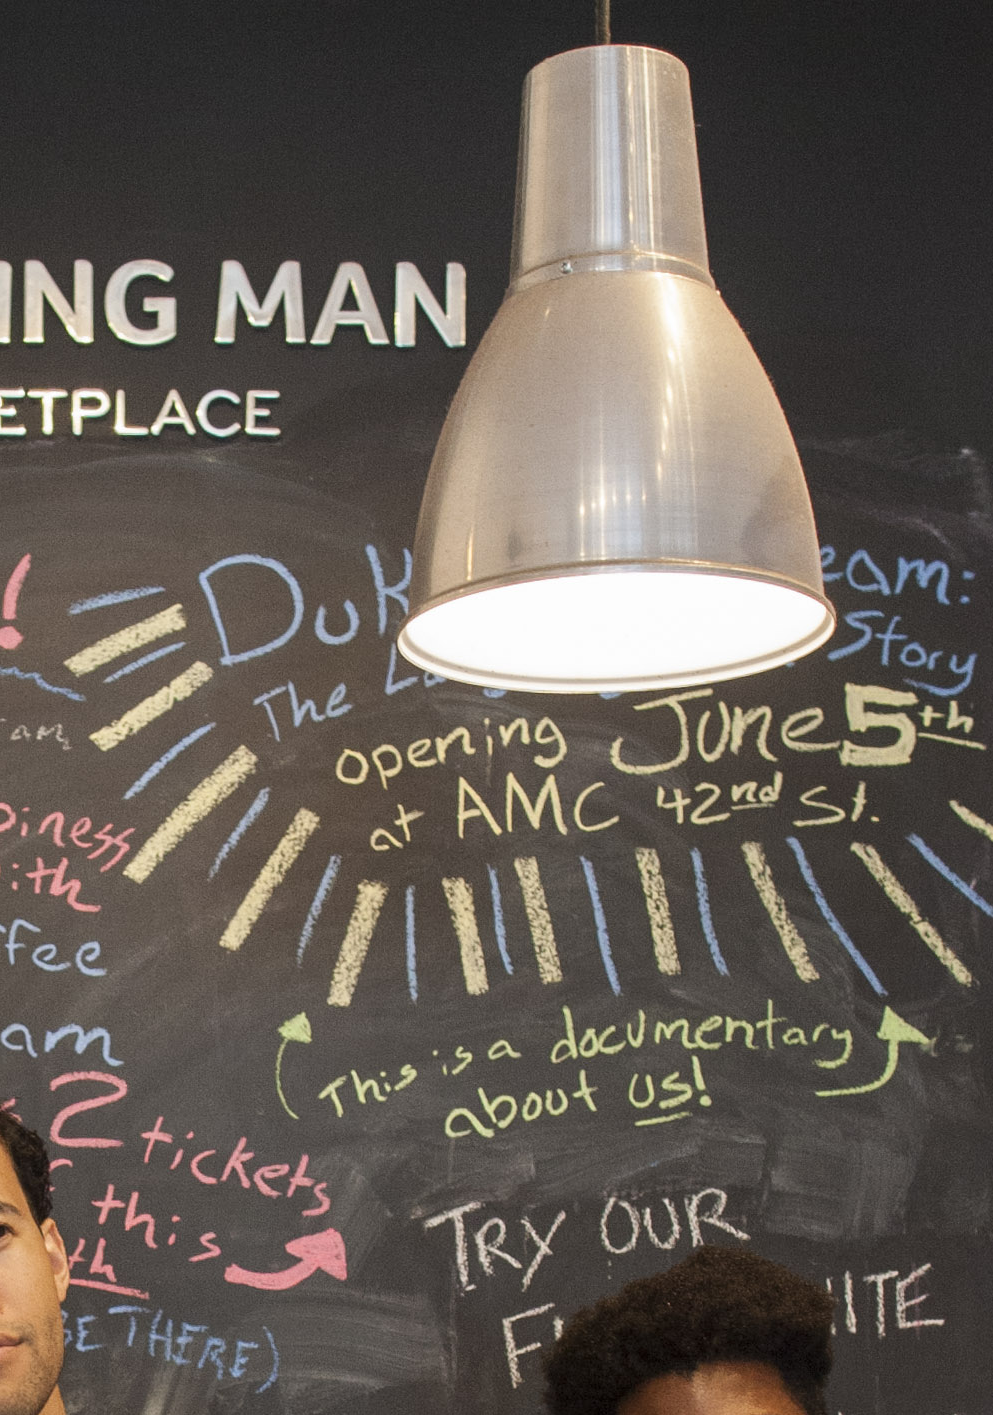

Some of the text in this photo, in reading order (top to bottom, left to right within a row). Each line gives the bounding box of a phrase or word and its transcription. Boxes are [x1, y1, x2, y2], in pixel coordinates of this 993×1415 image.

[213, 259, 468, 347] MAN
[254, 610, 978, 741] The Story
[336, 682, 986, 787] opening June 5th
[368, 807, 425, 852] at
[456, 774, 620, 836] AMC
[656, 770, 783, 825] 42nd
[317, 1000, 853, 1117] This is a documentary
[444, 1056, 712, 1138] about us!
[49, 1070, 128, 1147] 2
[141, 1116, 331, 1216] tickets
[91, 1184, 221, 1262] this
[422, 1187, 752, 1295] TRY OUR
